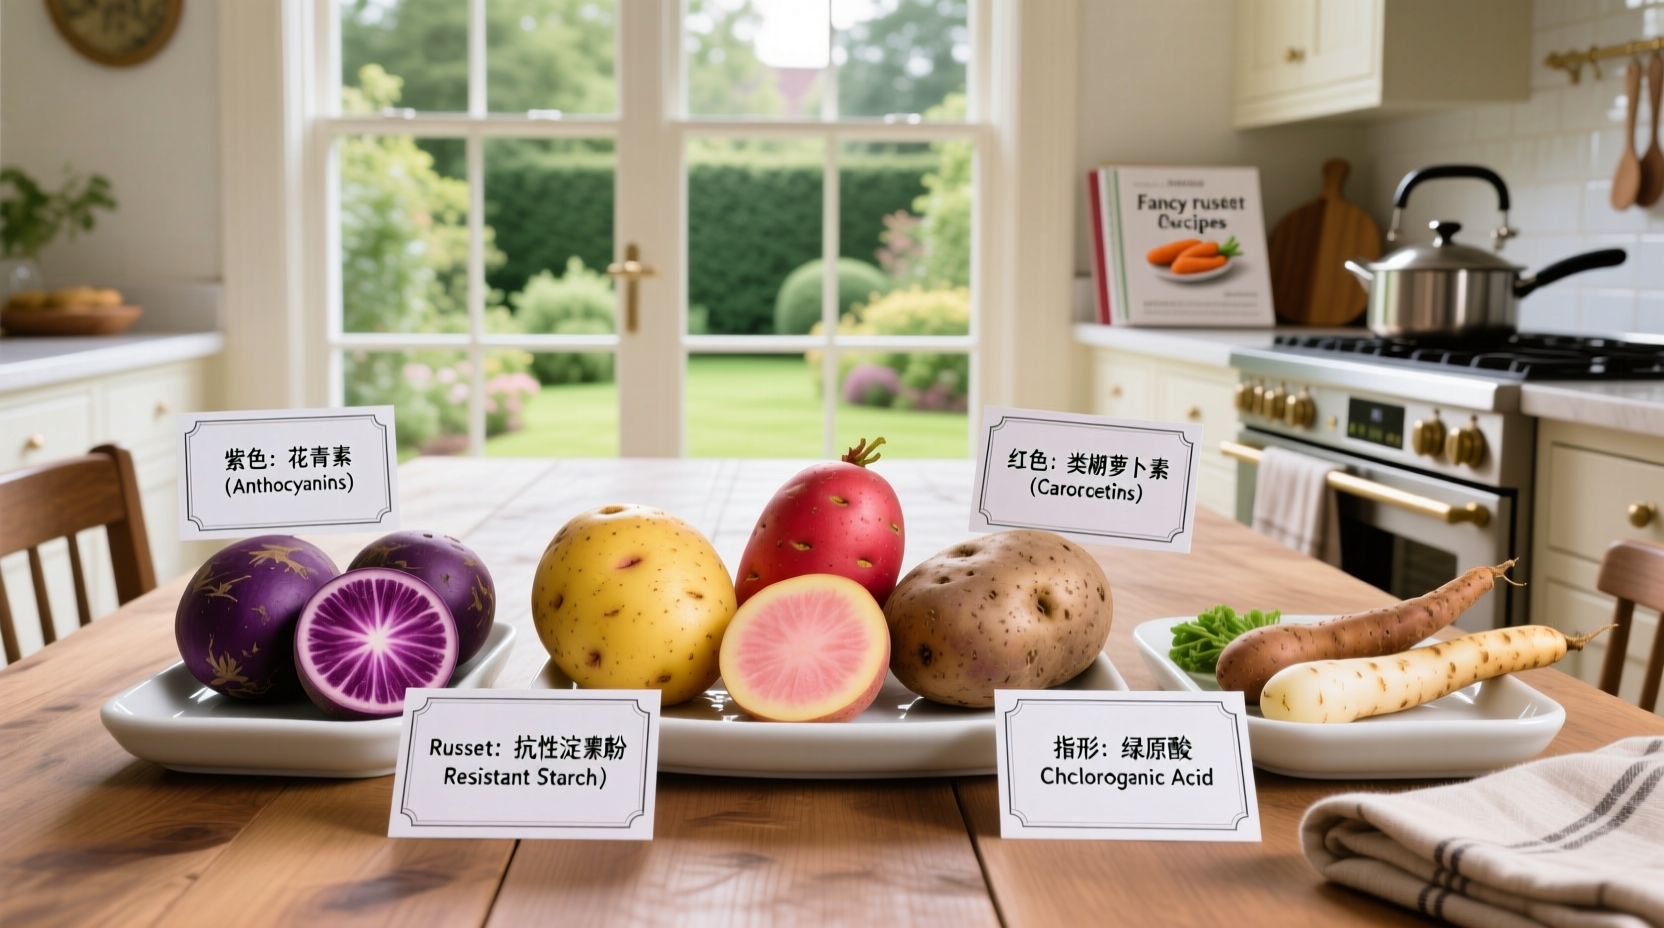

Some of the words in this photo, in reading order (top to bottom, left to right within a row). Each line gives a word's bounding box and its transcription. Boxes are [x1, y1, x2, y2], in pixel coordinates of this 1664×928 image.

[1137, 193, 1187, 215] Fancy
[225, 472, 354, 498] (Anthocyanins)
[443, 766, 530, 786] Resistant
[537, 766, 607, 790] Starch)
[1040, 766, 1165, 791] Chcloroganic
[1171, 767, 1214, 786] Acid
